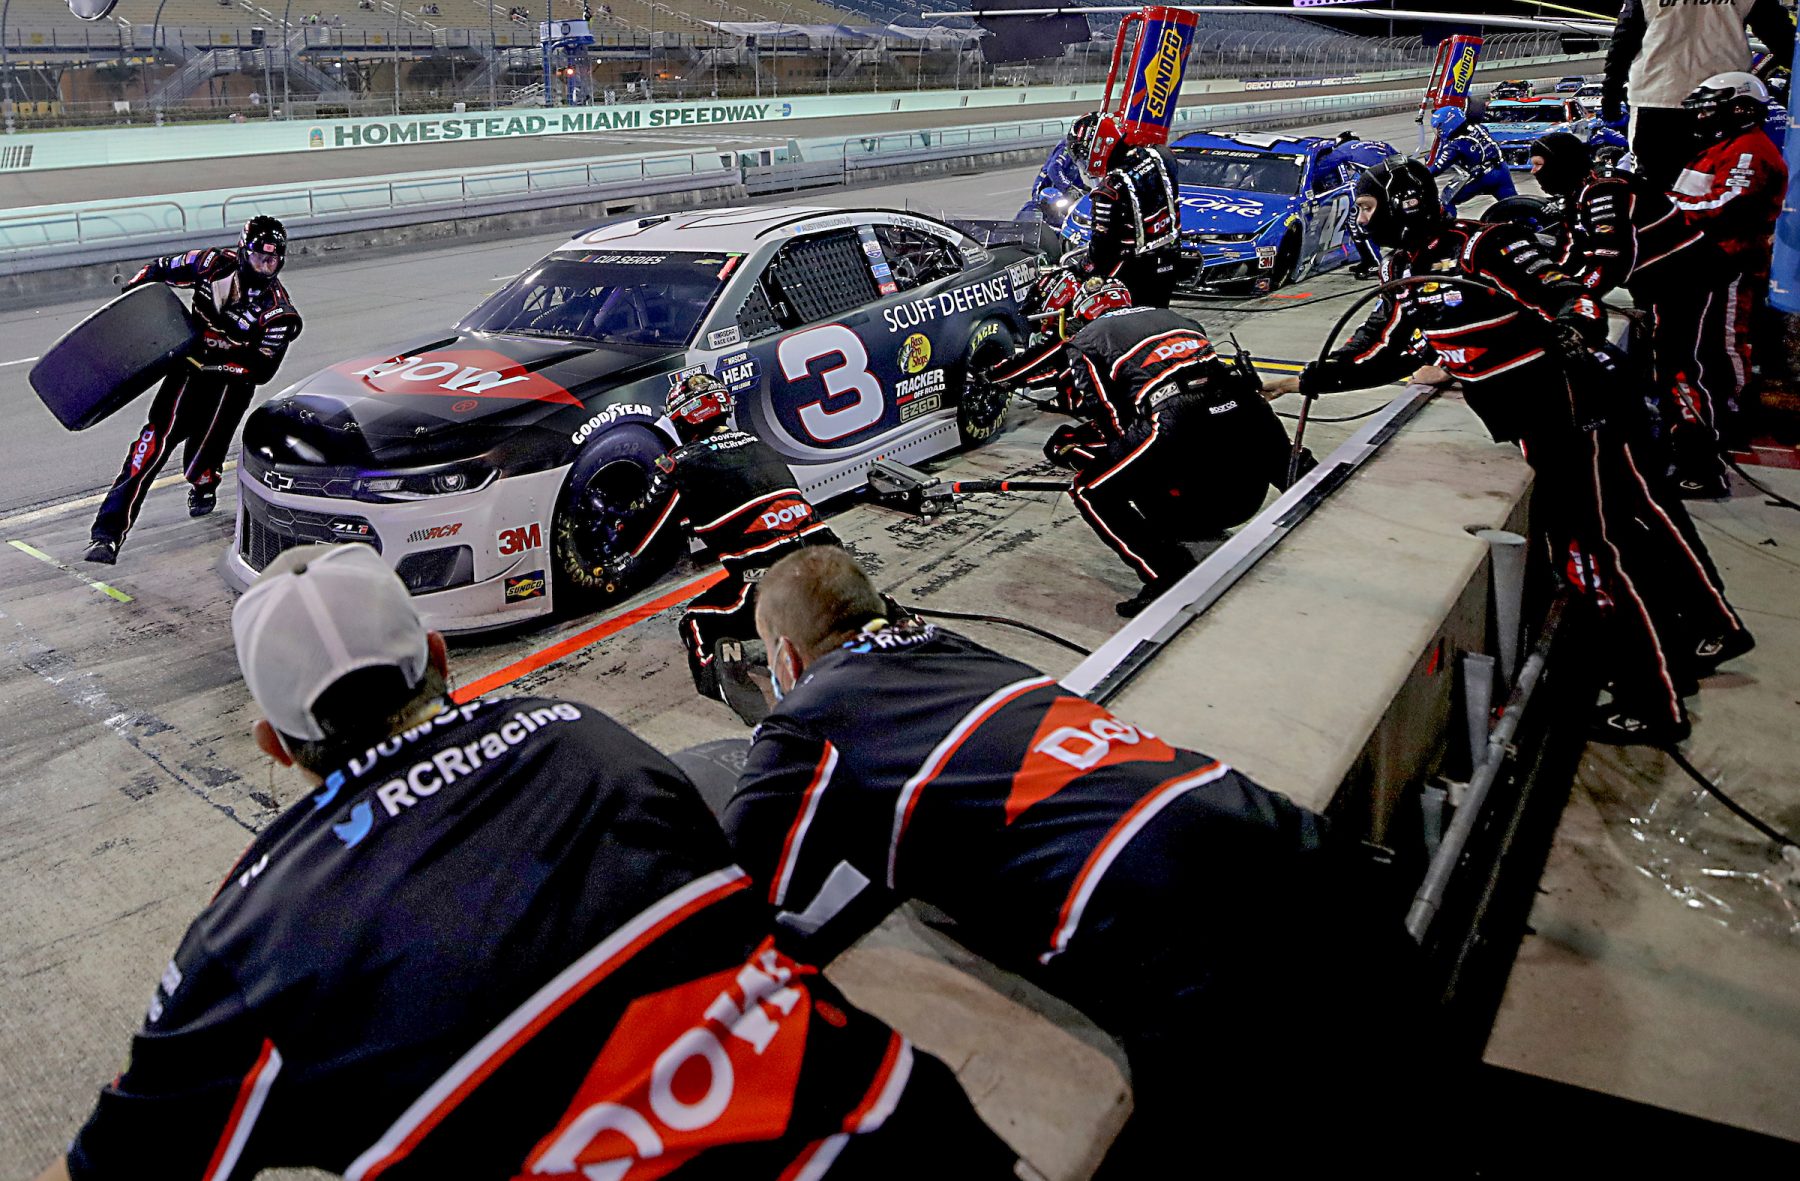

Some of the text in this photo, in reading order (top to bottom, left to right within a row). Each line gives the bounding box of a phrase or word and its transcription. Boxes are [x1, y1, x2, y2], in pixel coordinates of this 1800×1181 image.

[1149, 31, 1181, 115] SUNOCO
[1455, 48, 1474, 91] SUNOCO
[1246, 81, 1271, 90] GEICO
[1272, 80, 1296, 88] GEICO
[335, 111, 640, 146] HOMESTEAD-MIAMI
[649, 104, 769, 126] SPEEDWAY
[900, 218, 953, 238] REALTREE
[593, 255, 666, 265] CUP SERIES
[1260, 256, 1273, 267] 3M
[883, 276, 1009, 333] SCUFF DEFENSE
[1107, 290, 1121, 299] 3
[713, 335, 737, 346] RACE CAR
[910, 335, 924, 346] Bass
[971, 323, 999, 350] EAGLE
[727, 352, 748, 366] NASCAR
[1153, 339, 1198, 361] DOW
[223, 365, 244, 373] DOW
[911, 355, 928, 368] Shops
[351, 356, 530, 394] DOW
[721, 361, 754, 386] HEAT
[776, 321, 885, 443] 3
[895, 368, 945, 397] TRACKER
[714, 392, 727, 402] 3
[913, 383, 946, 399] OFF ROAD
[1209, 400, 1238, 413] sparco
[571, 402, 653, 446] GOODYEAR
[131, 430, 154, 470] DOW
[717, 435, 759, 450] RCRracing
[761, 503, 809, 530] DOW
[332, 522, 369, 535] ZL1
[424, 523, 463, 540] RCR
[498, 523, 542, 555] 3M
[507, 580, 544, 596] SUNOCO
[722, 642, 742, 663] N
[1033, 718, 1158, 772] DO
[376, 702, 582, 818] RCRracing
